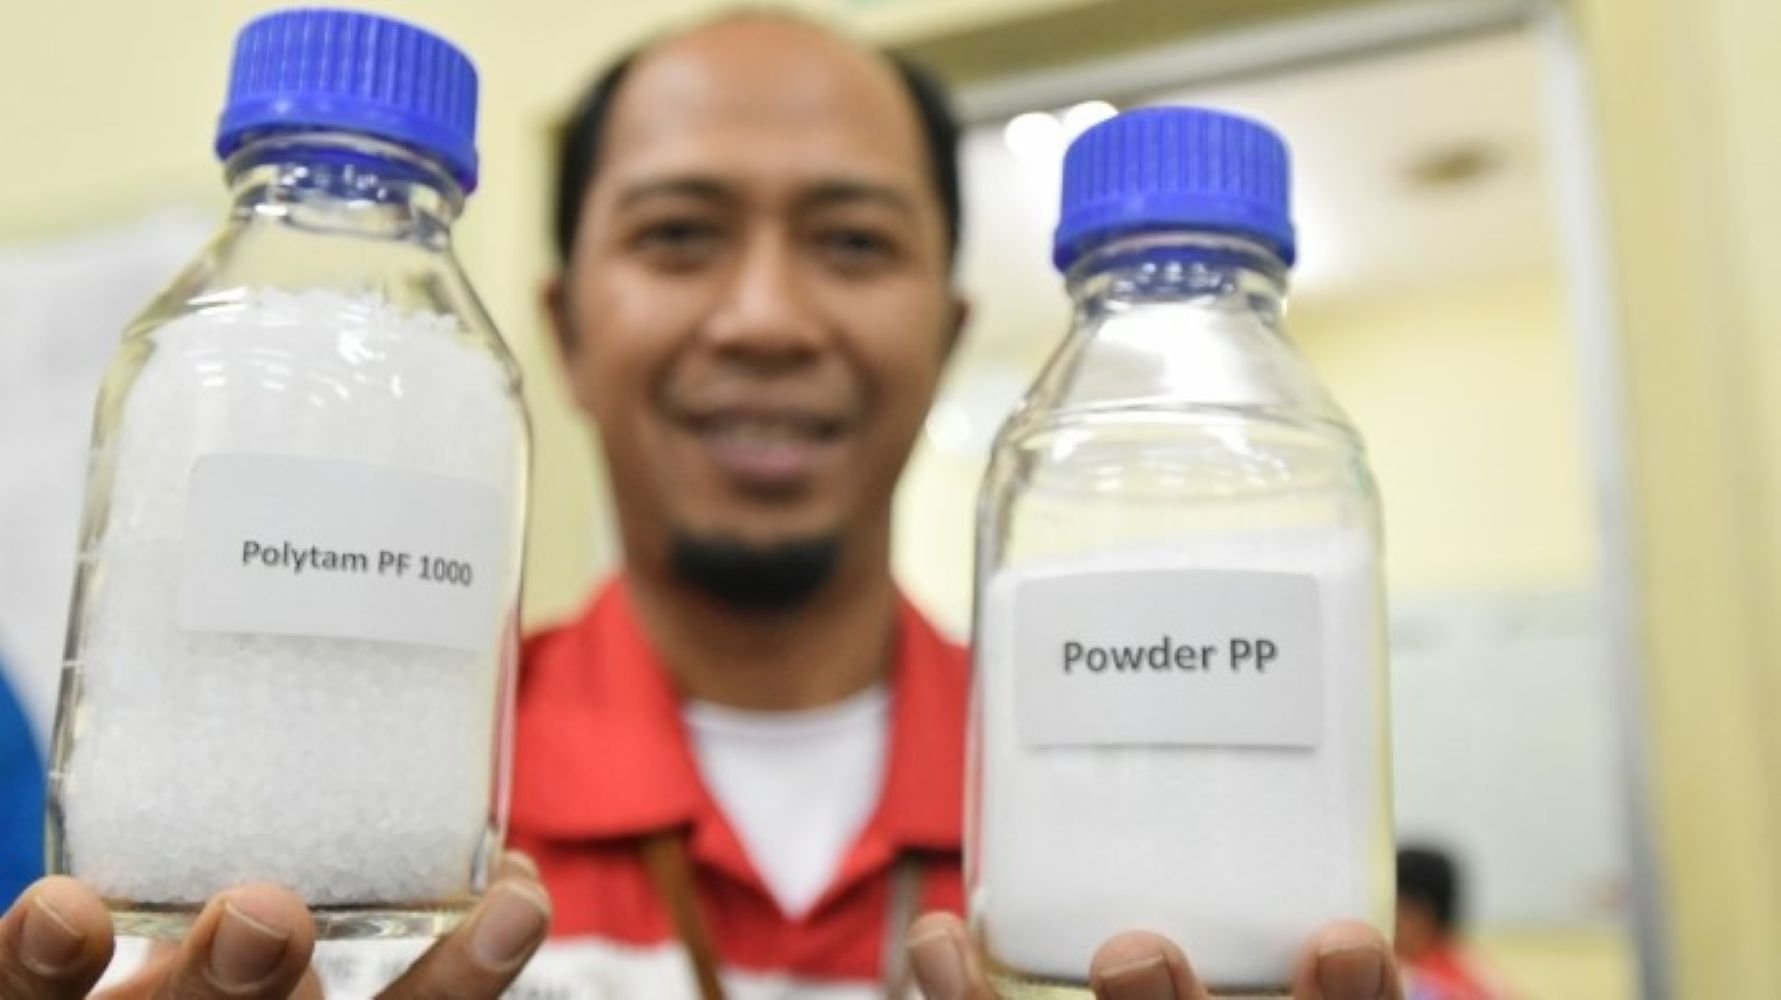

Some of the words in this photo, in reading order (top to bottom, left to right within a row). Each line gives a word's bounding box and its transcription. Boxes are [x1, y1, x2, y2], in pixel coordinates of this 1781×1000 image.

[241, 539, 368, 573] Polytam
[376, 550, 411, 575] PF
[418, 555, 473, 587] 1000
[1062, 635, 1215, 673] Powder
[1229, 637, 1278, 672] PP
